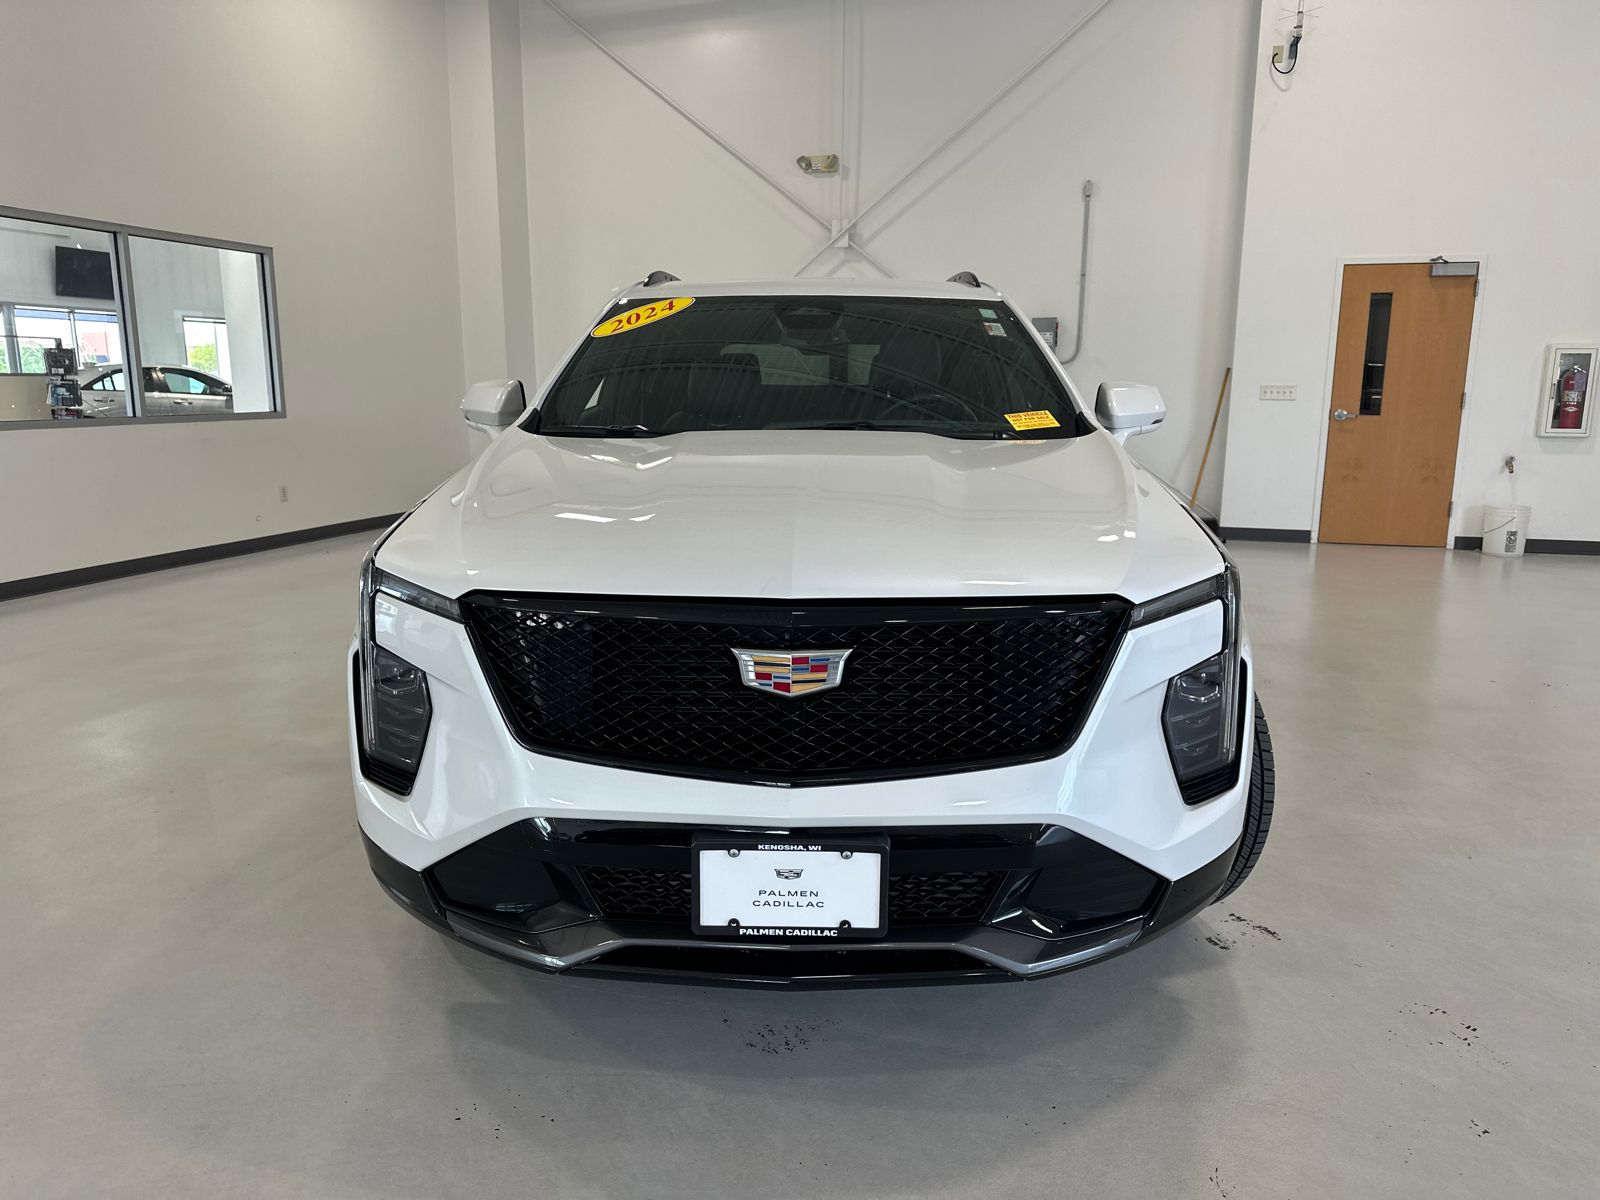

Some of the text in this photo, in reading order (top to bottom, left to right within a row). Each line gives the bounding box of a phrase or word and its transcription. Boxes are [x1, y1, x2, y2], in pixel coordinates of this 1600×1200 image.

[610, 300, 675, 333] 2024
[752, 900, 825, 908] CADILLAC
[739, 928, 838, 937] PALMEN CADILLAC
